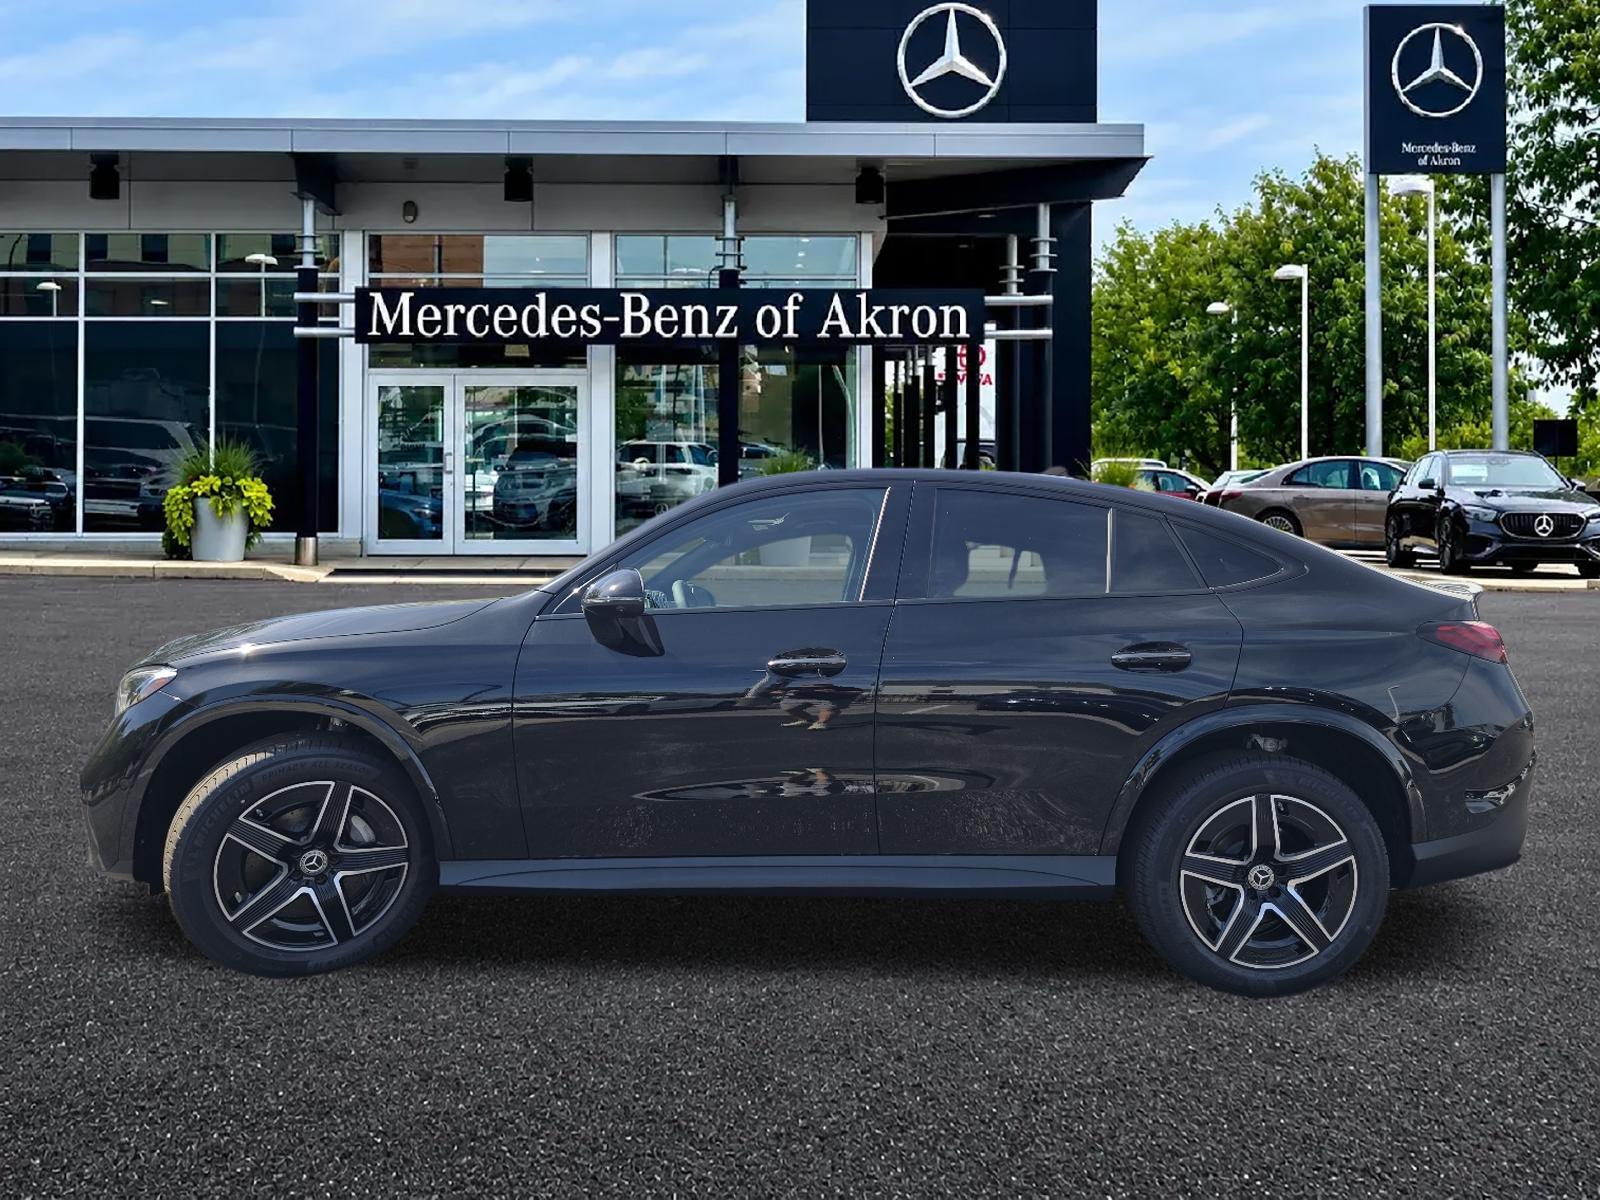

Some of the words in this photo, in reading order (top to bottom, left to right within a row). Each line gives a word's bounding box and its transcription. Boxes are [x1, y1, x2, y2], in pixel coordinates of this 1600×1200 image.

[1401, 141, 1477, 154] Mercedes-Benz
[1417, 154, 1428, 166] of
[1429, 154, 1461, 166] Akron
[367, 291, 738, 338] Mercedes-Benz
[755, 292, 804, 338] of
[816, 291, 971, 338] Akron
